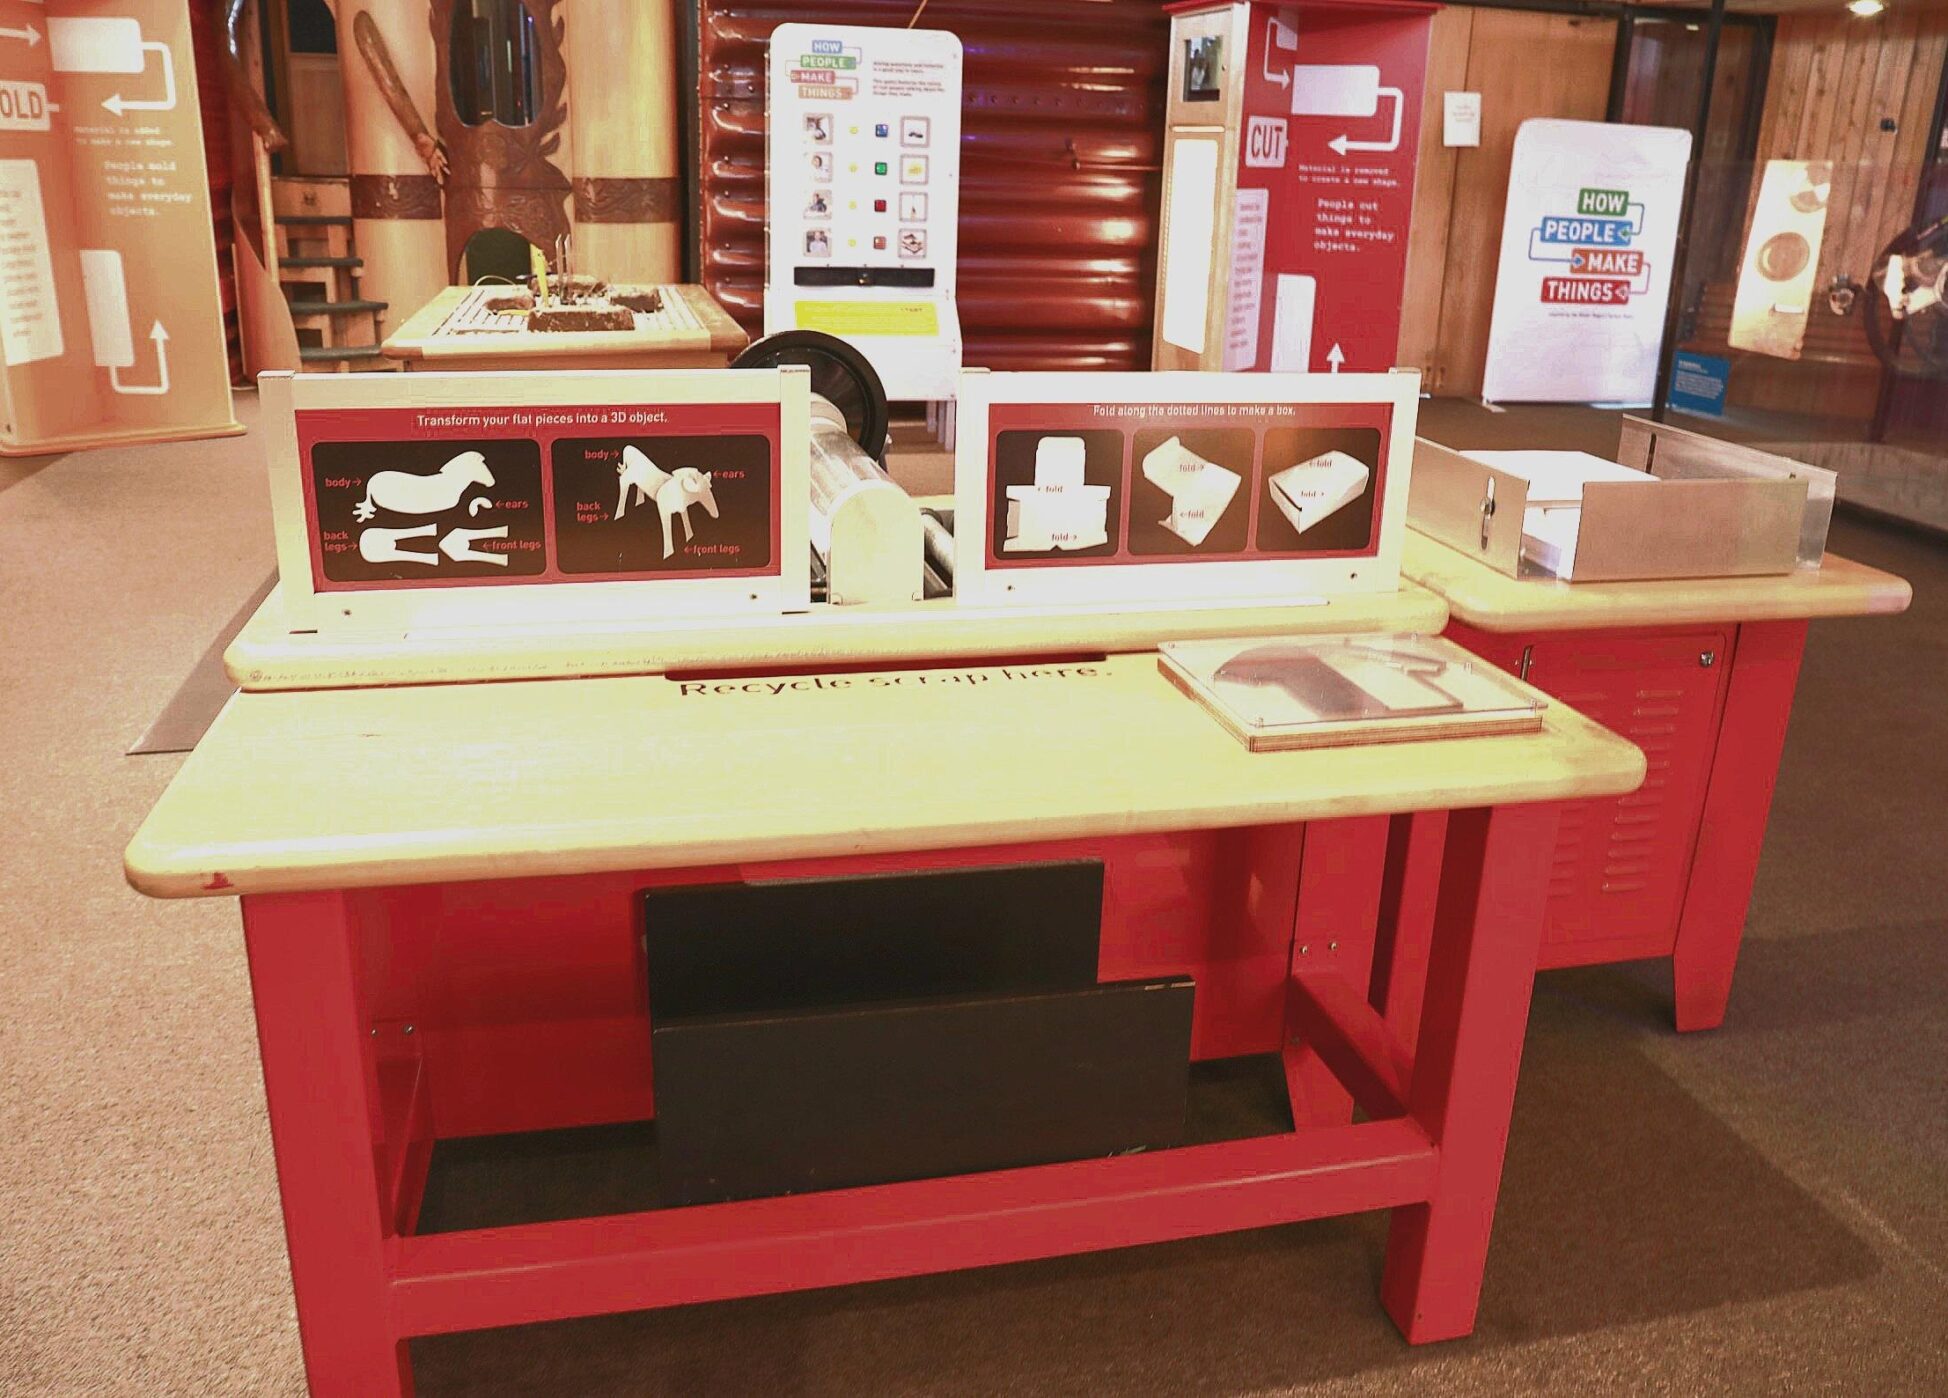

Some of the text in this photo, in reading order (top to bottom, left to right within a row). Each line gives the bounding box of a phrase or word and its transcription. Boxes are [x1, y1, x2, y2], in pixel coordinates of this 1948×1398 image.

[814, 42, 840, 52] HOW
[802, 56, 845, 68] PEOPLE
[801, 72, 832, 83] MAKE
[802, 87, 842, 99] THINGS
[1251, 125, 1283, 159] CUT
[104, 160, 177, 173] People mold
[1298, 164, 1336, 174] Material
[1354, 166, 1390, 175] removed
[105, 176, 146, 188] things
[1311, 176, 1341, 184] create
[1373, 177, 1399, 188] shape.
[107, 192, 192, 204] make everyday
[1582, 191, 1625, 213] HOW
[1318, 198, 1378, 211] People cut
[1316, 212, 1371, 225] things to
[1314, 226, 1395, 243] make everyday
[1545, 220, 1616, 243] PEOPLE
[1313, 239, 1361, 252] objects.
[1588, 252, 1640, 272] MAKE
[1547, 280, 1613, 302] THINGS
[1093, 404, 1114, 415] Fold
[1117, 404, 1145, 418] along
[1148, 404, 1164, 415] the
[1167, 404, 1198, 415] dotted
[1201, 404, 1225, 415] lines
[1227, 404, 1237, 415] to
[1240, 404, 1265, 415] make
[1276, 404, 1296, 415] box.
[417, 410, 668, 428] Transform your flat pieces into a 3D object.
[584, 450, 609, 461] body
[1179, 464, 1196, 473] fold
[1316, 459, 1333, 468] fold
[722, 471, 745, 479] ears
[325, 478, 351, 489] body
[1046, 485, 1063, 493] fold
[1301, 490, 1317, 498] fold
[505, 500, 529, 509] ears
[576, 501, 601, 511] back
[576, 513, 599, 524] legs
[1188, 509, 1204, 519] fold
[323, 530, 349, 540] back
[1051, 532, 1069, 541] fold
[324, 542, 348, 553] legs
[492, 540, 542, 552] front legs
[693, 544, 740, 556] front legs
[680, 678, 851, 697] Recycle
[868, 674, 989, 688] scrap
